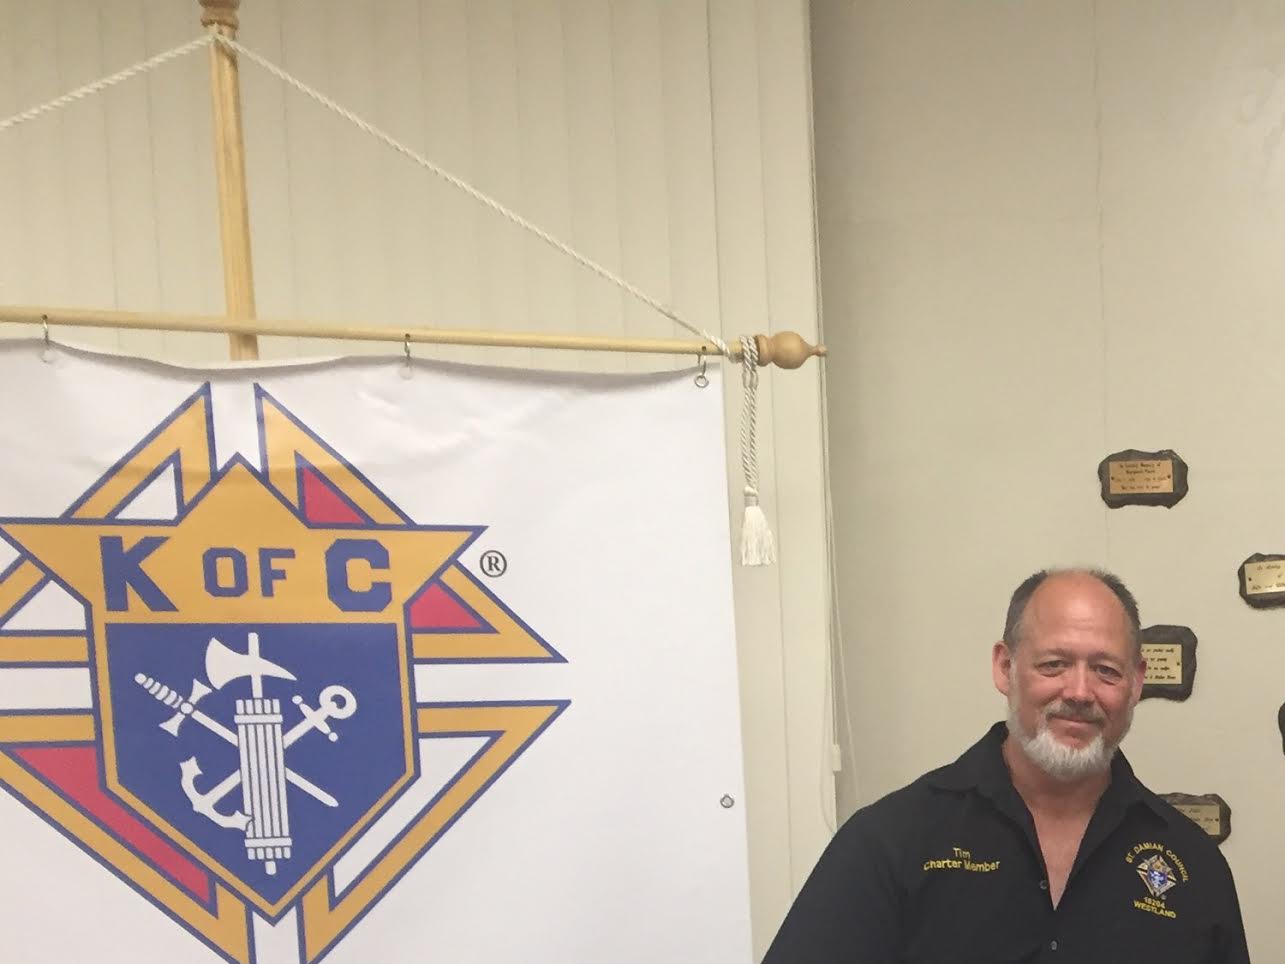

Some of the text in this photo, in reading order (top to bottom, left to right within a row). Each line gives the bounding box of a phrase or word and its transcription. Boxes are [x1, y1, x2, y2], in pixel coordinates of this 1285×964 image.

[100, 535, 393, 613] K OF C
[953, 847, 972, 860] Tim
[1133, 900, 1177, 919] WESTLAND
